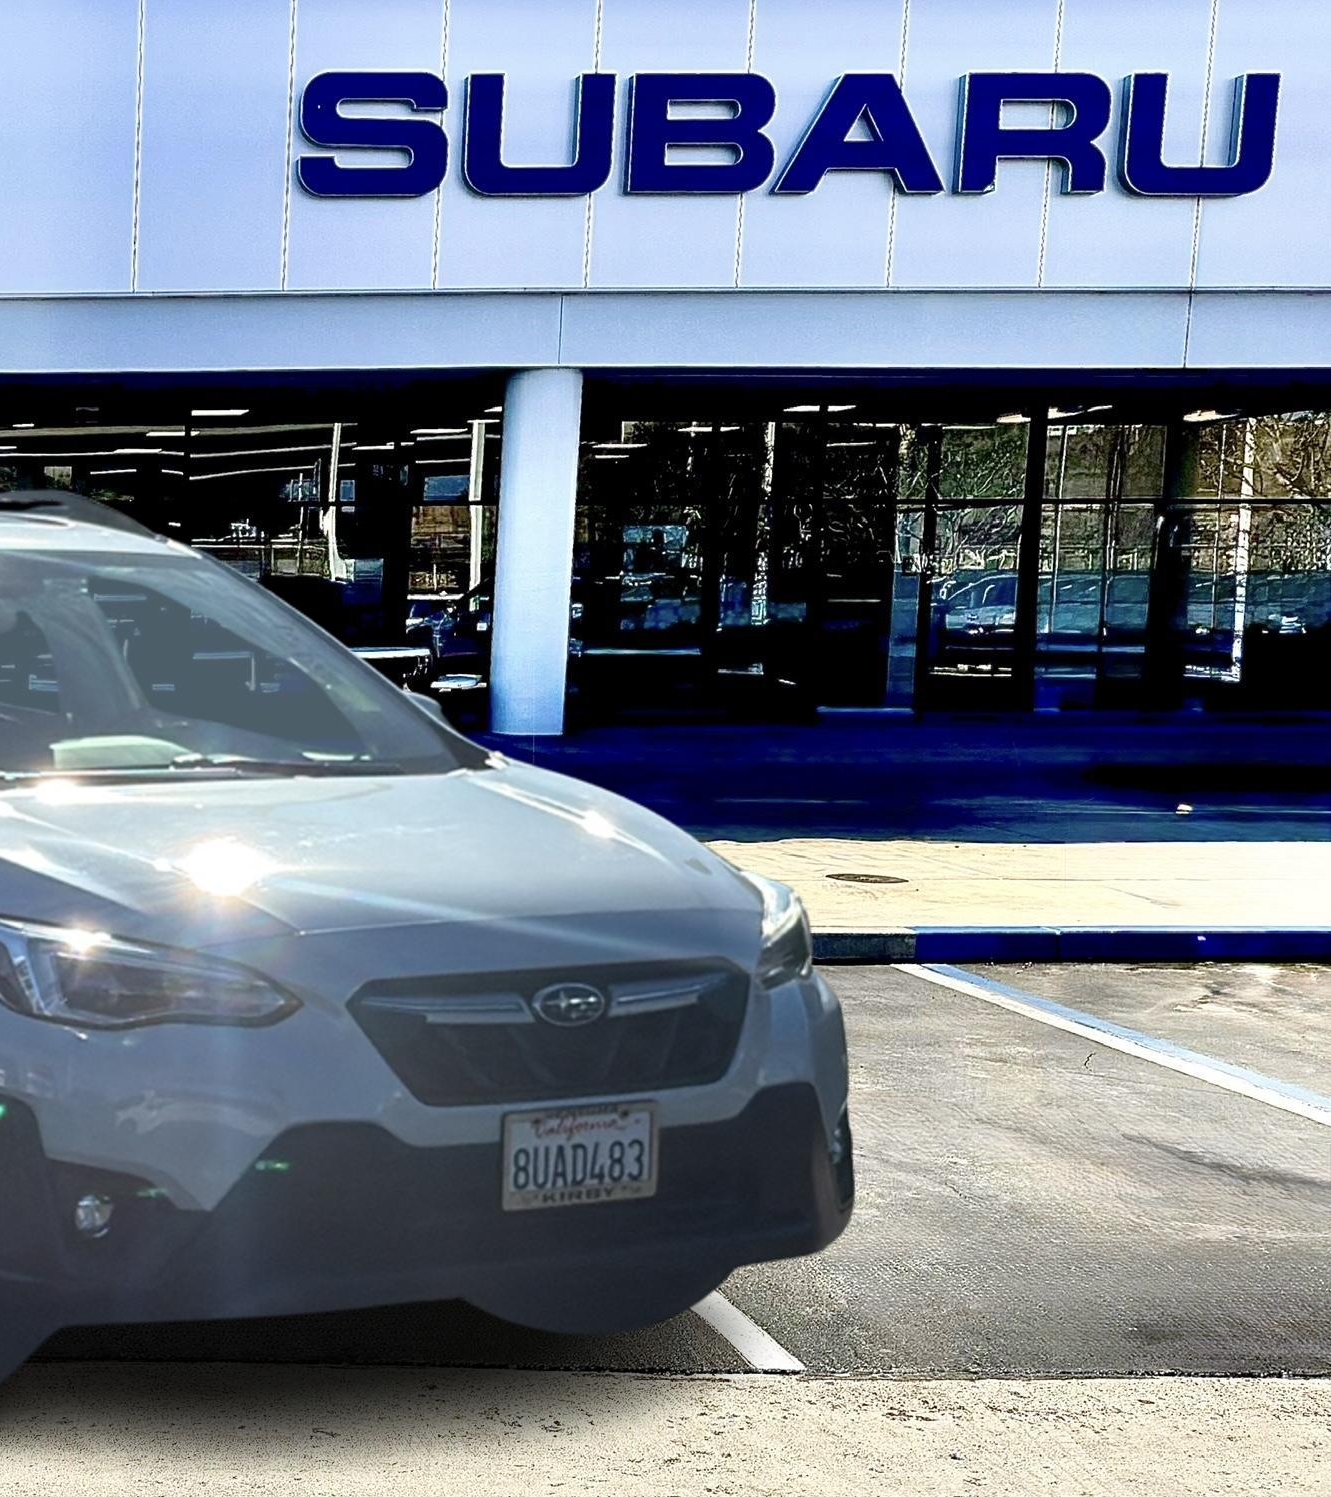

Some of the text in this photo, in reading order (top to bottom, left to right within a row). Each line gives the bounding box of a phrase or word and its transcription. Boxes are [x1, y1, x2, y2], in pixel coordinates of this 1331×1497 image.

[296, 71, 1282, 197] SUBARU
[513, 1138, 645, 1190] 8UAD483
[542, 1186, 614, 1203] KIRBY
